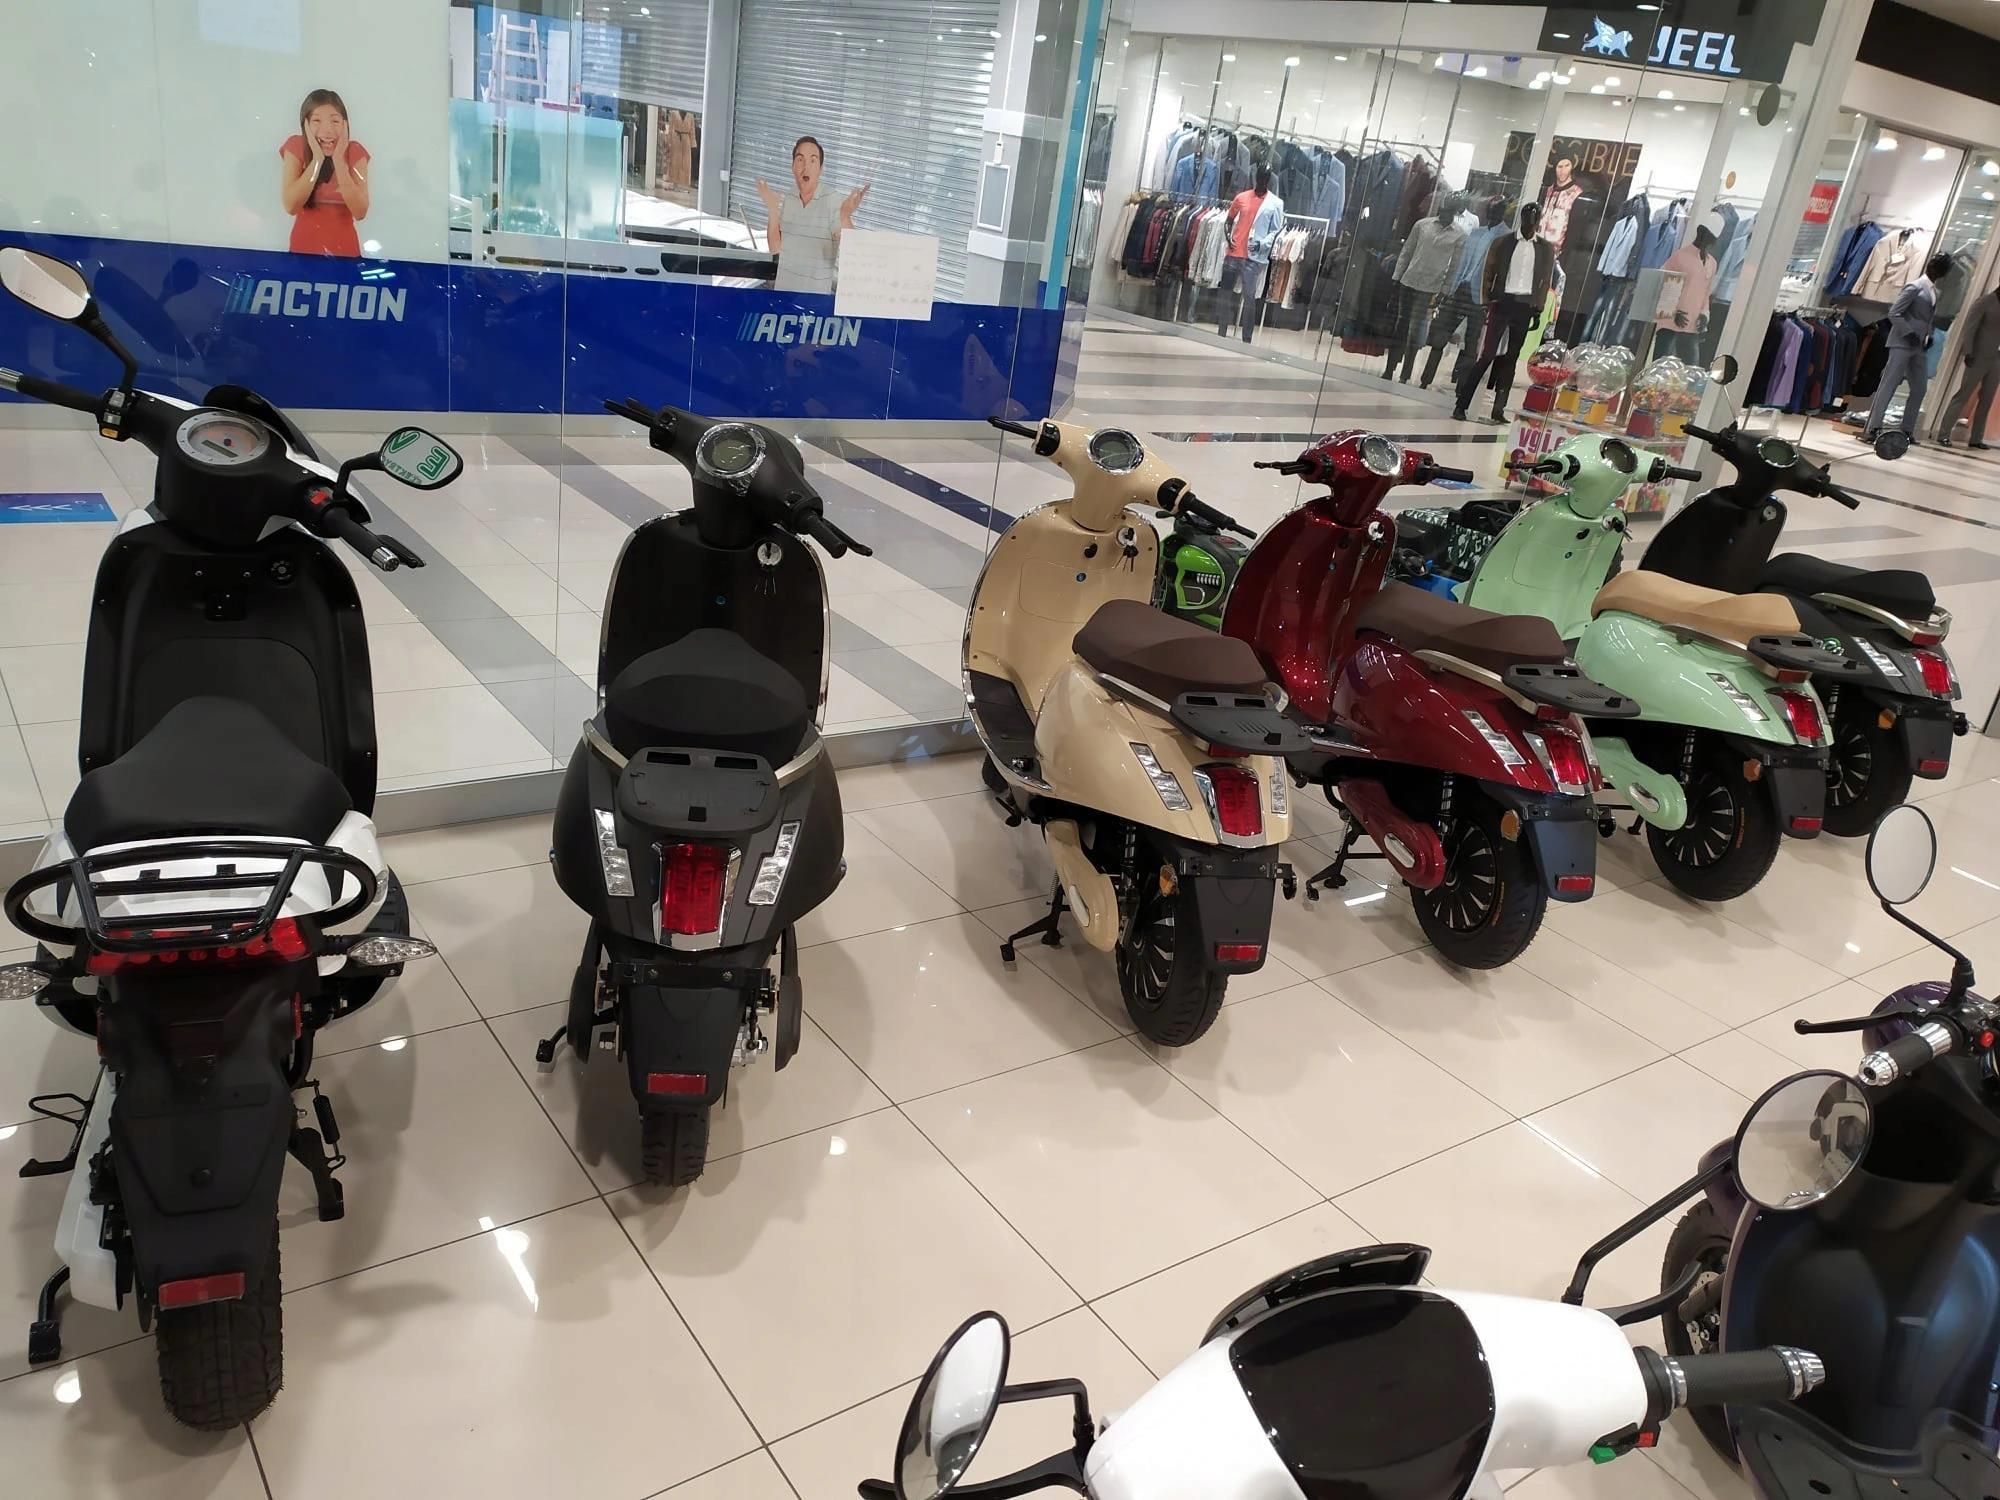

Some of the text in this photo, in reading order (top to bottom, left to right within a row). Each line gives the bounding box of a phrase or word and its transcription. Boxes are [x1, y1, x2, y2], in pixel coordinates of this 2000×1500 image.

[1647, 25, 1742, 74] JEEL
[249, 279, 408, 322] ACTION
[753, 313, 862, 347] ACTION
